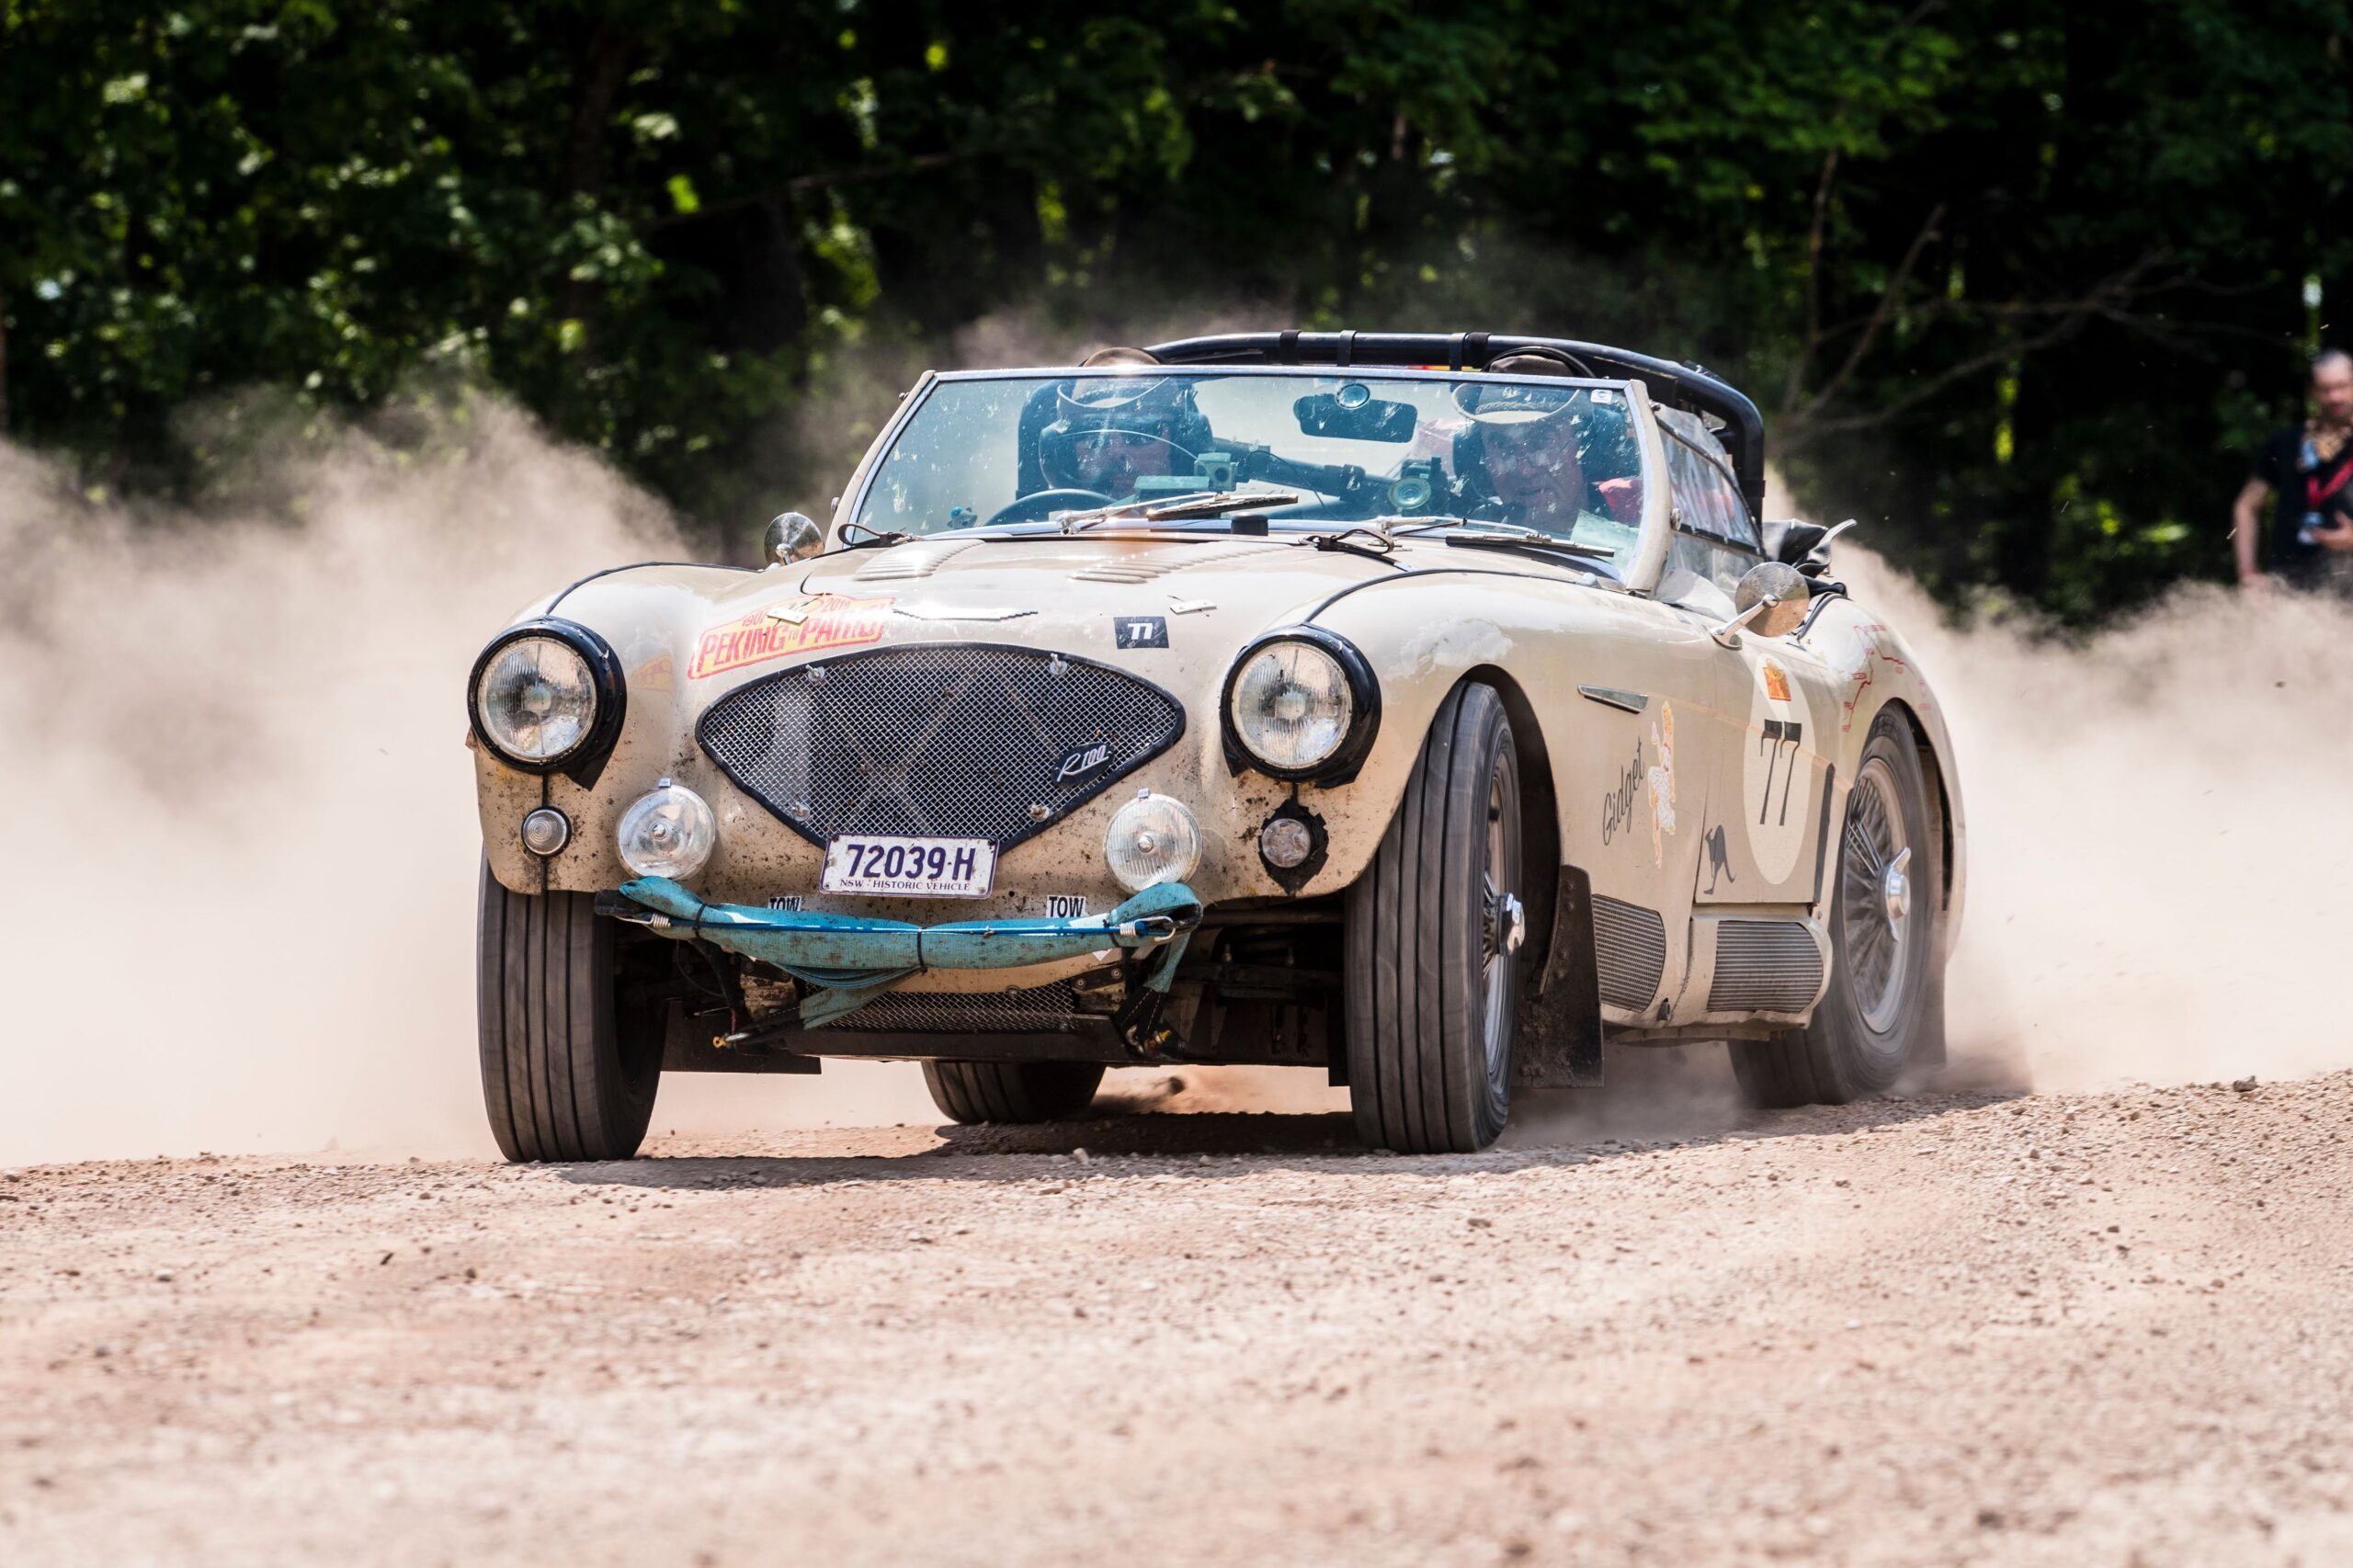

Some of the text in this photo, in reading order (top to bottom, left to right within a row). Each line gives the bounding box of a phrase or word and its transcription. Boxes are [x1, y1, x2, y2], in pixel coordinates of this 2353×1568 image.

[1127, 622, 1154, 641] 77
[697, 624, 790, 673] PEKING
[1759, 719, 1802, 826] 77
[1603, 735, 1644, 846] Gidget
[840, 879, 971, 891] NSW HISTORIC VEHICLE
[769, 897, 801, 911] TOW
[1049, 896, 1085, 918] TOW
